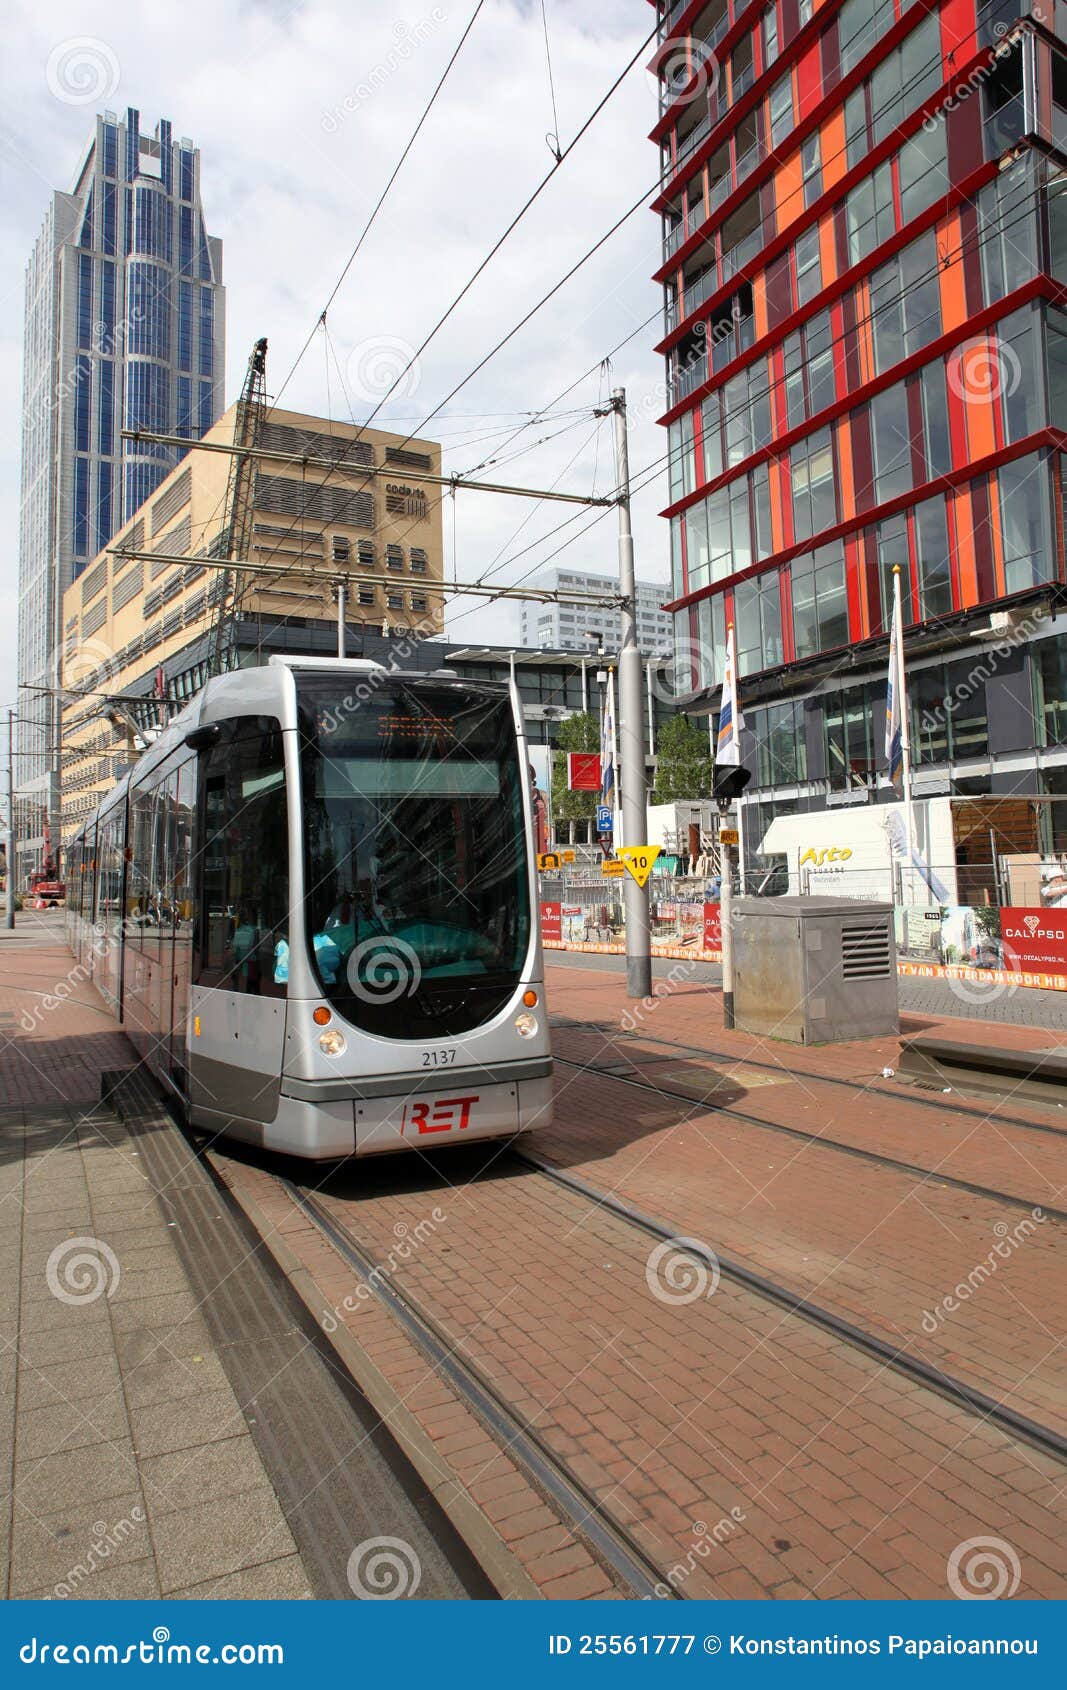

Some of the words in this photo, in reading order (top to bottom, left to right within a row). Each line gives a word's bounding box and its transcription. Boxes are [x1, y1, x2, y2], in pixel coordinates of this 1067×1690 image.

[632, 857, 647, 868] 10
[1005, 928, 1064, 940] CALYPSO
[911, 967, 933, 977] VAN
[937, 968, 1004, 985] ROTTERDAM
[422, 1049, 456, 1066] 2137
[410, 1095, 479, 1134] RET
